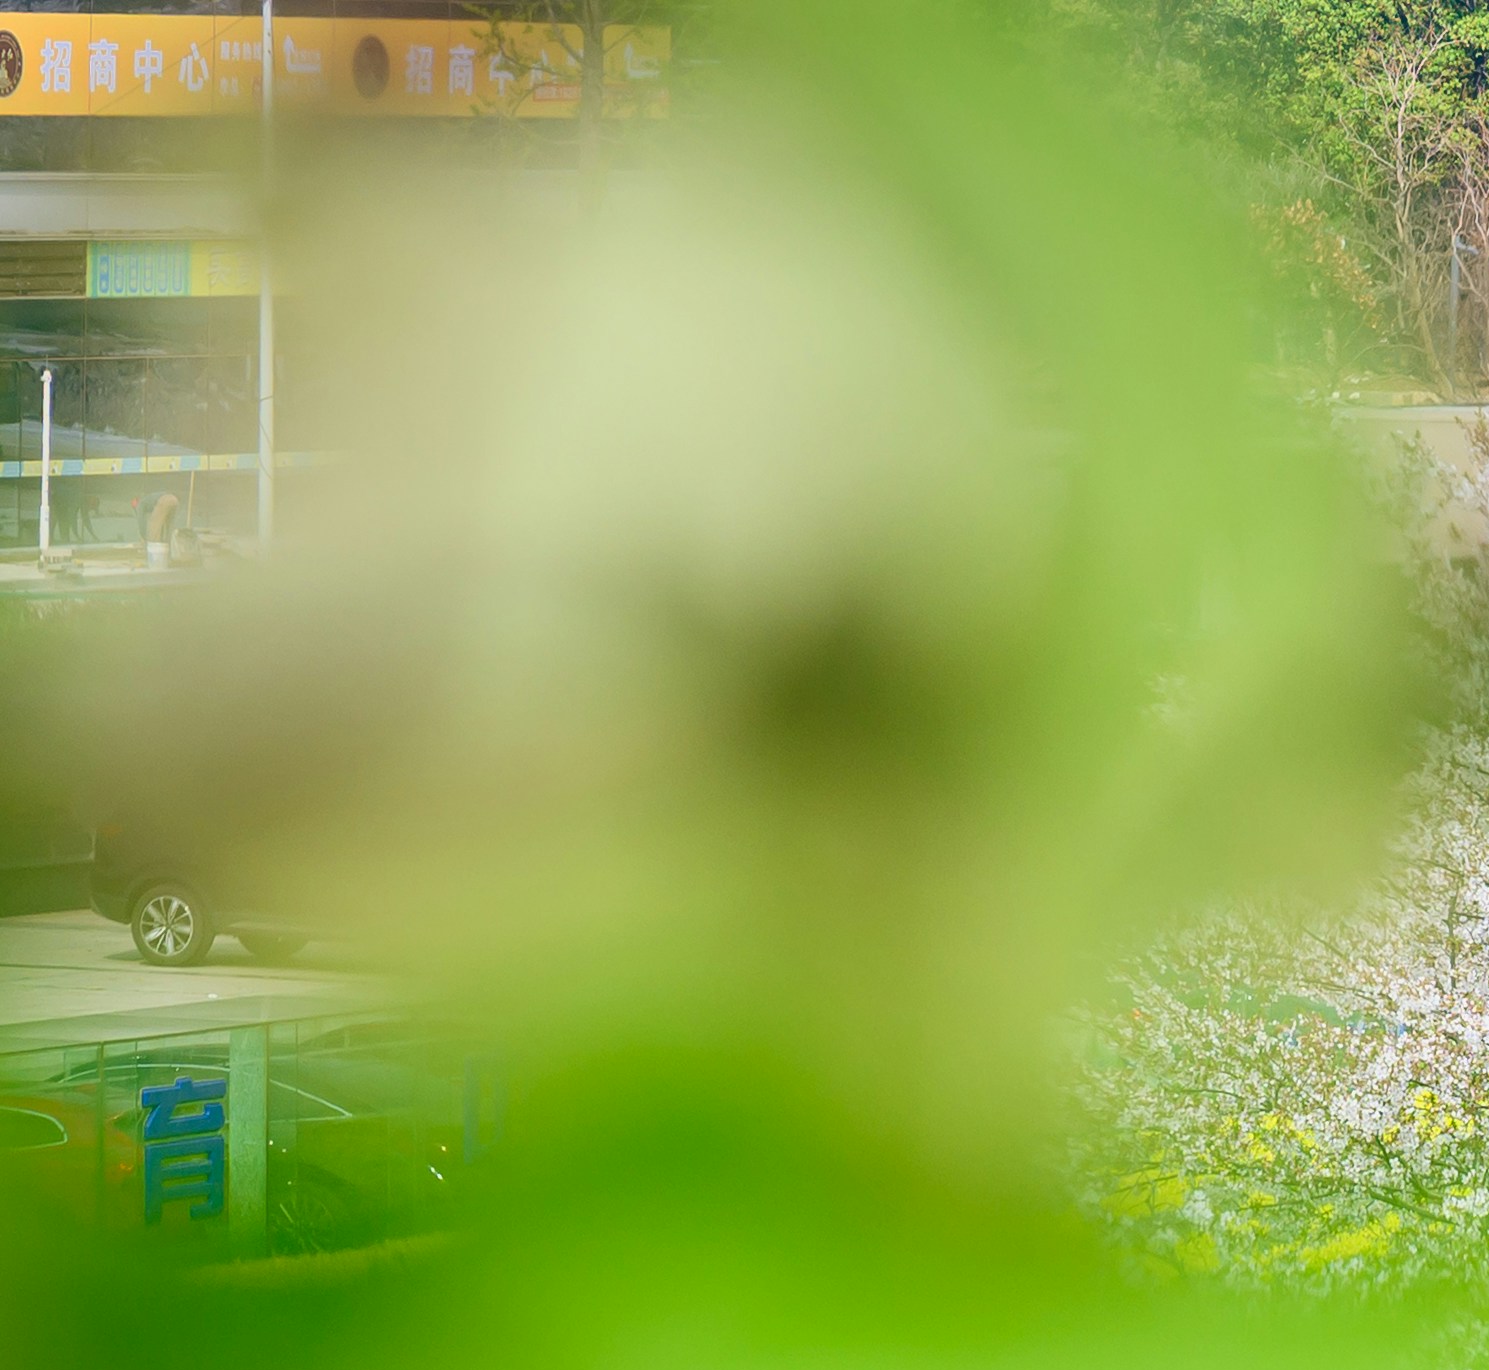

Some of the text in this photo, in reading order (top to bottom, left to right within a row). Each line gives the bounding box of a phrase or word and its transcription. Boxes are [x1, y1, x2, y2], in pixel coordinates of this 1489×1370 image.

[40, 37, 209, 93] 招商中心
[141, 1077, 226, 1224] 育
